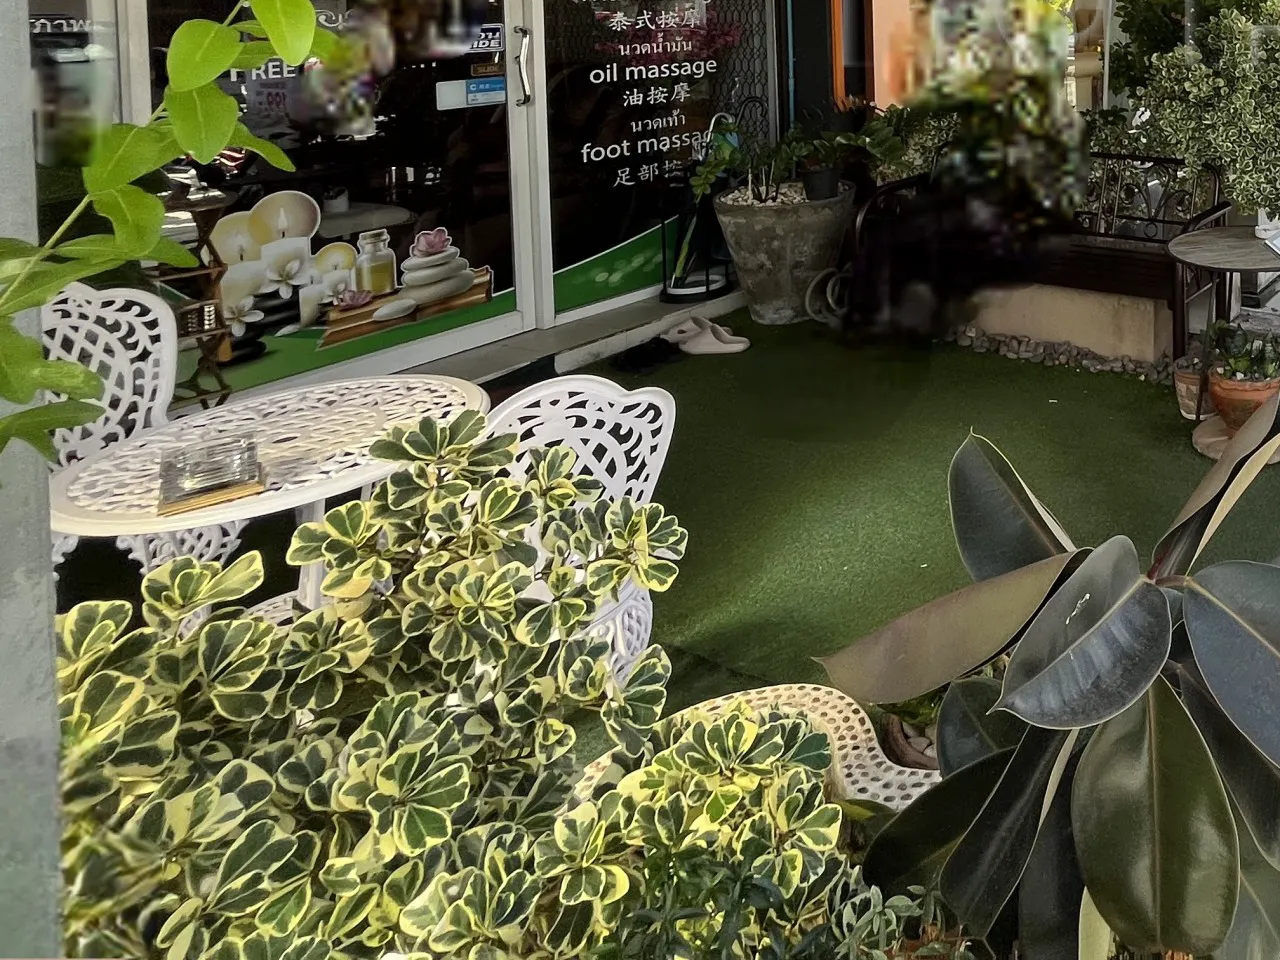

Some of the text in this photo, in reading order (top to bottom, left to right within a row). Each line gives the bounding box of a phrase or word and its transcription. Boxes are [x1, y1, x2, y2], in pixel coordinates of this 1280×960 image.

[609, 9, 703, 32] 泰式按摩
[619, 33, 693, 56] นวดน้ำมัน
[589, 59, 718, 84] oil massage
[623, 82, 691, 108] 油按摩
[630, 109, 687, 133] นวดเท้า
[580, 129, 714, 163] foot massag
[612, 159, 686, 188] 足部按
